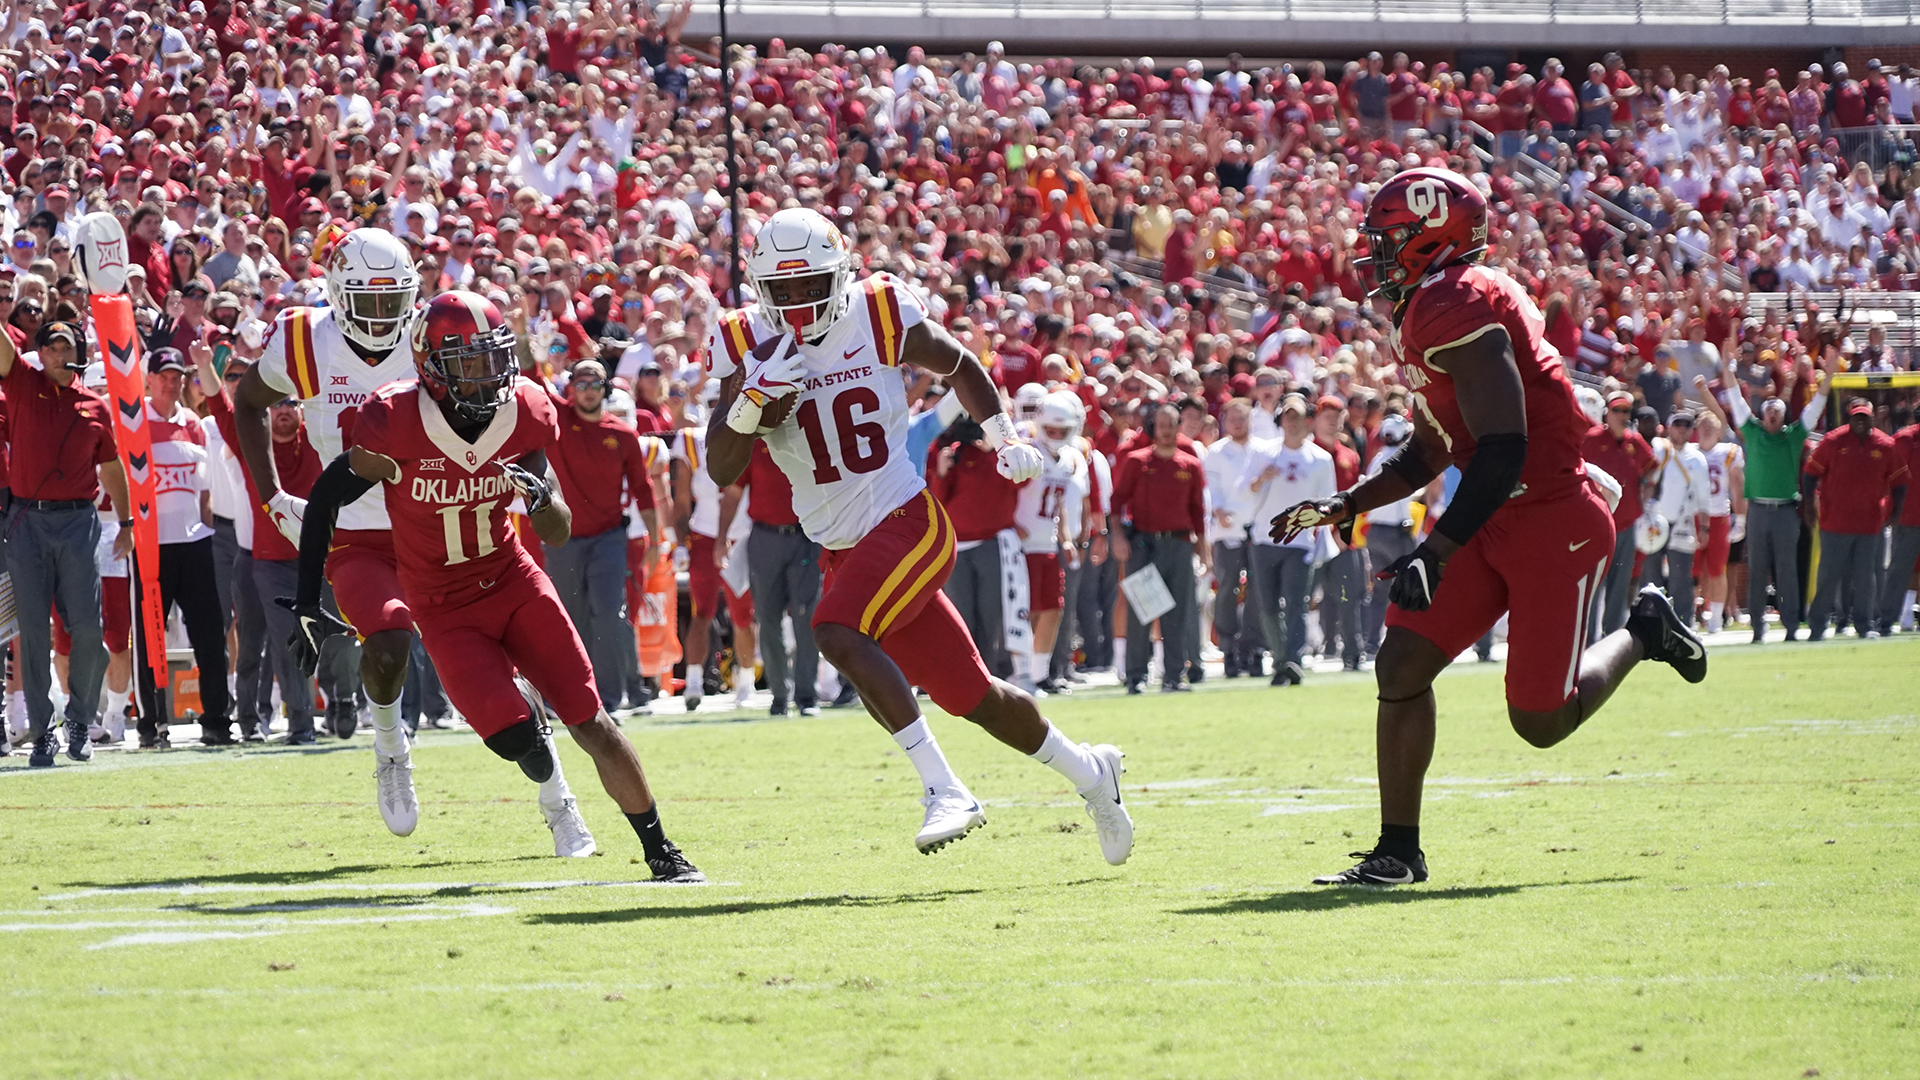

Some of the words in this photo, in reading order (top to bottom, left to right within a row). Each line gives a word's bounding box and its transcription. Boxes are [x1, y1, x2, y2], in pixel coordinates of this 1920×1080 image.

[1406, 180, 1449, 228] OU
[329, 375, 349, 386] XII
[824, 366, 872, 386] STATE
[328, 393, 367, 404] IOWA
[796, 387, 889, 485] 16
[419, 457, 446, 471] XII
[466, 451, 477, 466] OU
[411, 475, 512, 504] OKLAHOM
[436, 500, 499, 566] 11
